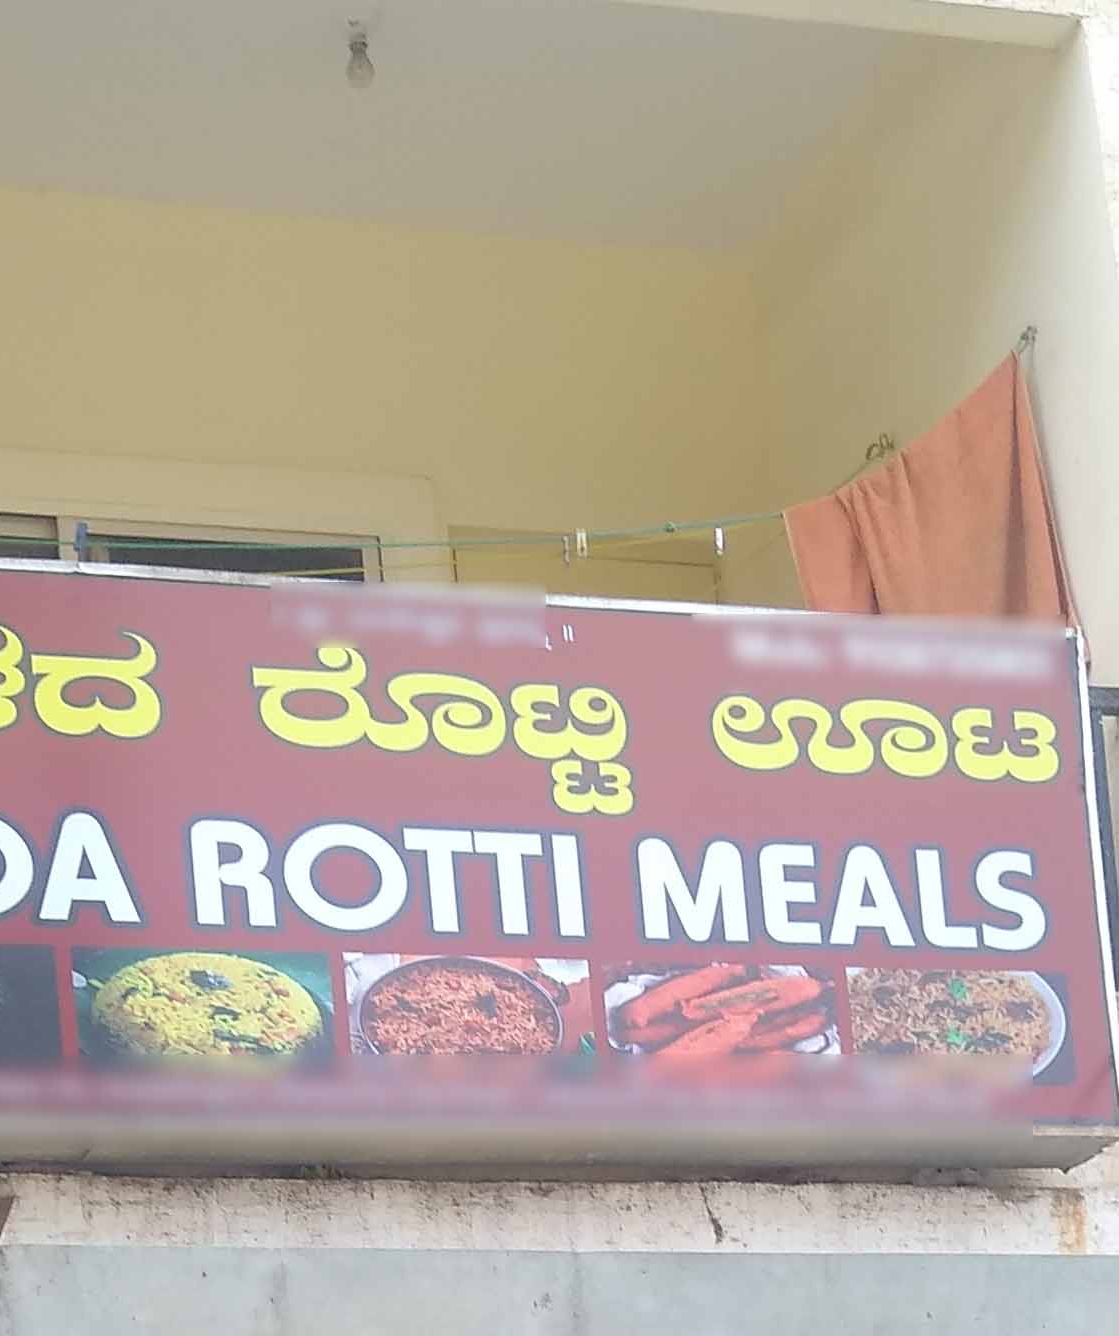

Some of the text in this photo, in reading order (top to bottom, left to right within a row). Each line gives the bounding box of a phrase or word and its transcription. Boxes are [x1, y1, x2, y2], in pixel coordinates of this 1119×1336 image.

[712, 694, 1059, 782] ಊಟ
[189, 819, 587, 938] ROTTI
[636, 837, 1048, 951] MEALS
